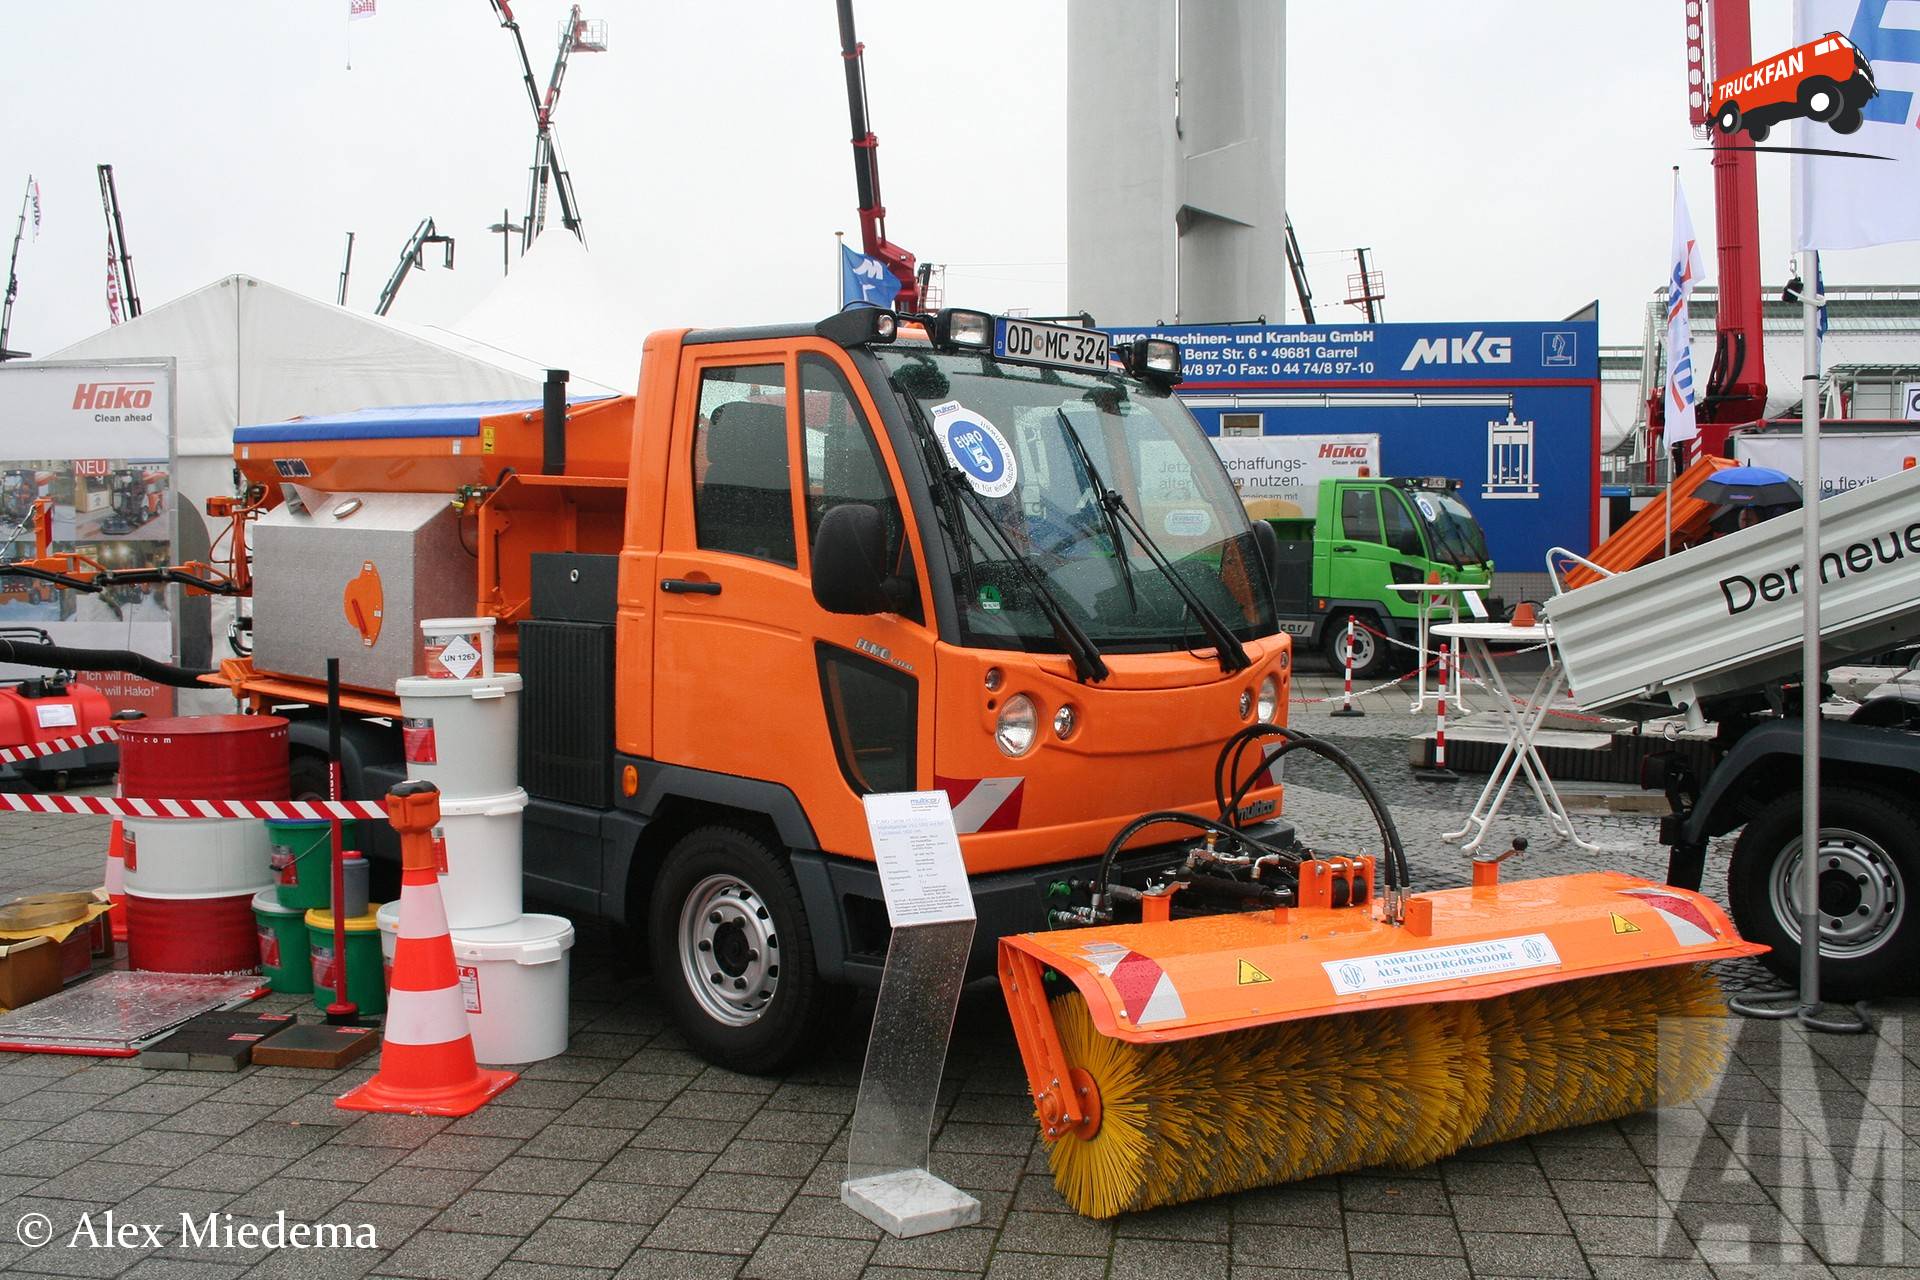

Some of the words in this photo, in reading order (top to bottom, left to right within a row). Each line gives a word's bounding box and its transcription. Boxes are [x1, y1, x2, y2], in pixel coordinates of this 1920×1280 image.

[1236, 332, 1262, 344] und
[1266, 332, 1326, 343] Kranbau
[1330, 330, 1374, 343] GmbH
[1008, 325, 1032, 355] OD
[1045, 331, 1069, 360] MC
[1074, 335, 1105, 365] 324
[1400, 331, 1511, 371] MKG
[1185, 348, 1218, 360] Benz
[1222, 348, 1245, 360] Str.
[1249, 348, 1257, 360] 6
[1271, 348, 1311, 359] 49681
[1315, 347, 1358, 359] Garrel
[1206, 364, 1236, 376] 97-0
[1240, 363, 1268, 375] Fax:
[1272, 363, 1280, 375] 0
[1283, 363, 1300, 374] 44
[1303, 363, 1333, 375] 74/8
[1336, 362, 1374, 374] 97-10
[72, 382, 154, 410] Hako
[94, 413, 121, 422] Clean
[124, 413, 153, 422] ahead
[954, 430, 983, 450] EURO
[1318, 442, 1369, 459] Hako
[75, 460, 107, 475] NEU
[1222, 457, 1307, 472] schaffungs-
[1250, 475, 1304, 487] nutzen.
[1719, 563, 1800, 616] Der
[444, 654, 456, 662] UN
[458, 653, 476, 662] 1263
[105, 671, 121, 681] will
[105, 686, 121, 697] will
[1374, 942, 1507, 967] FAHRZEUGAUFBAUTEN
[1377, 965, 1401, 979] AUS
[1404, 951, 1514, 974] NIEDERGÖRSDORF
